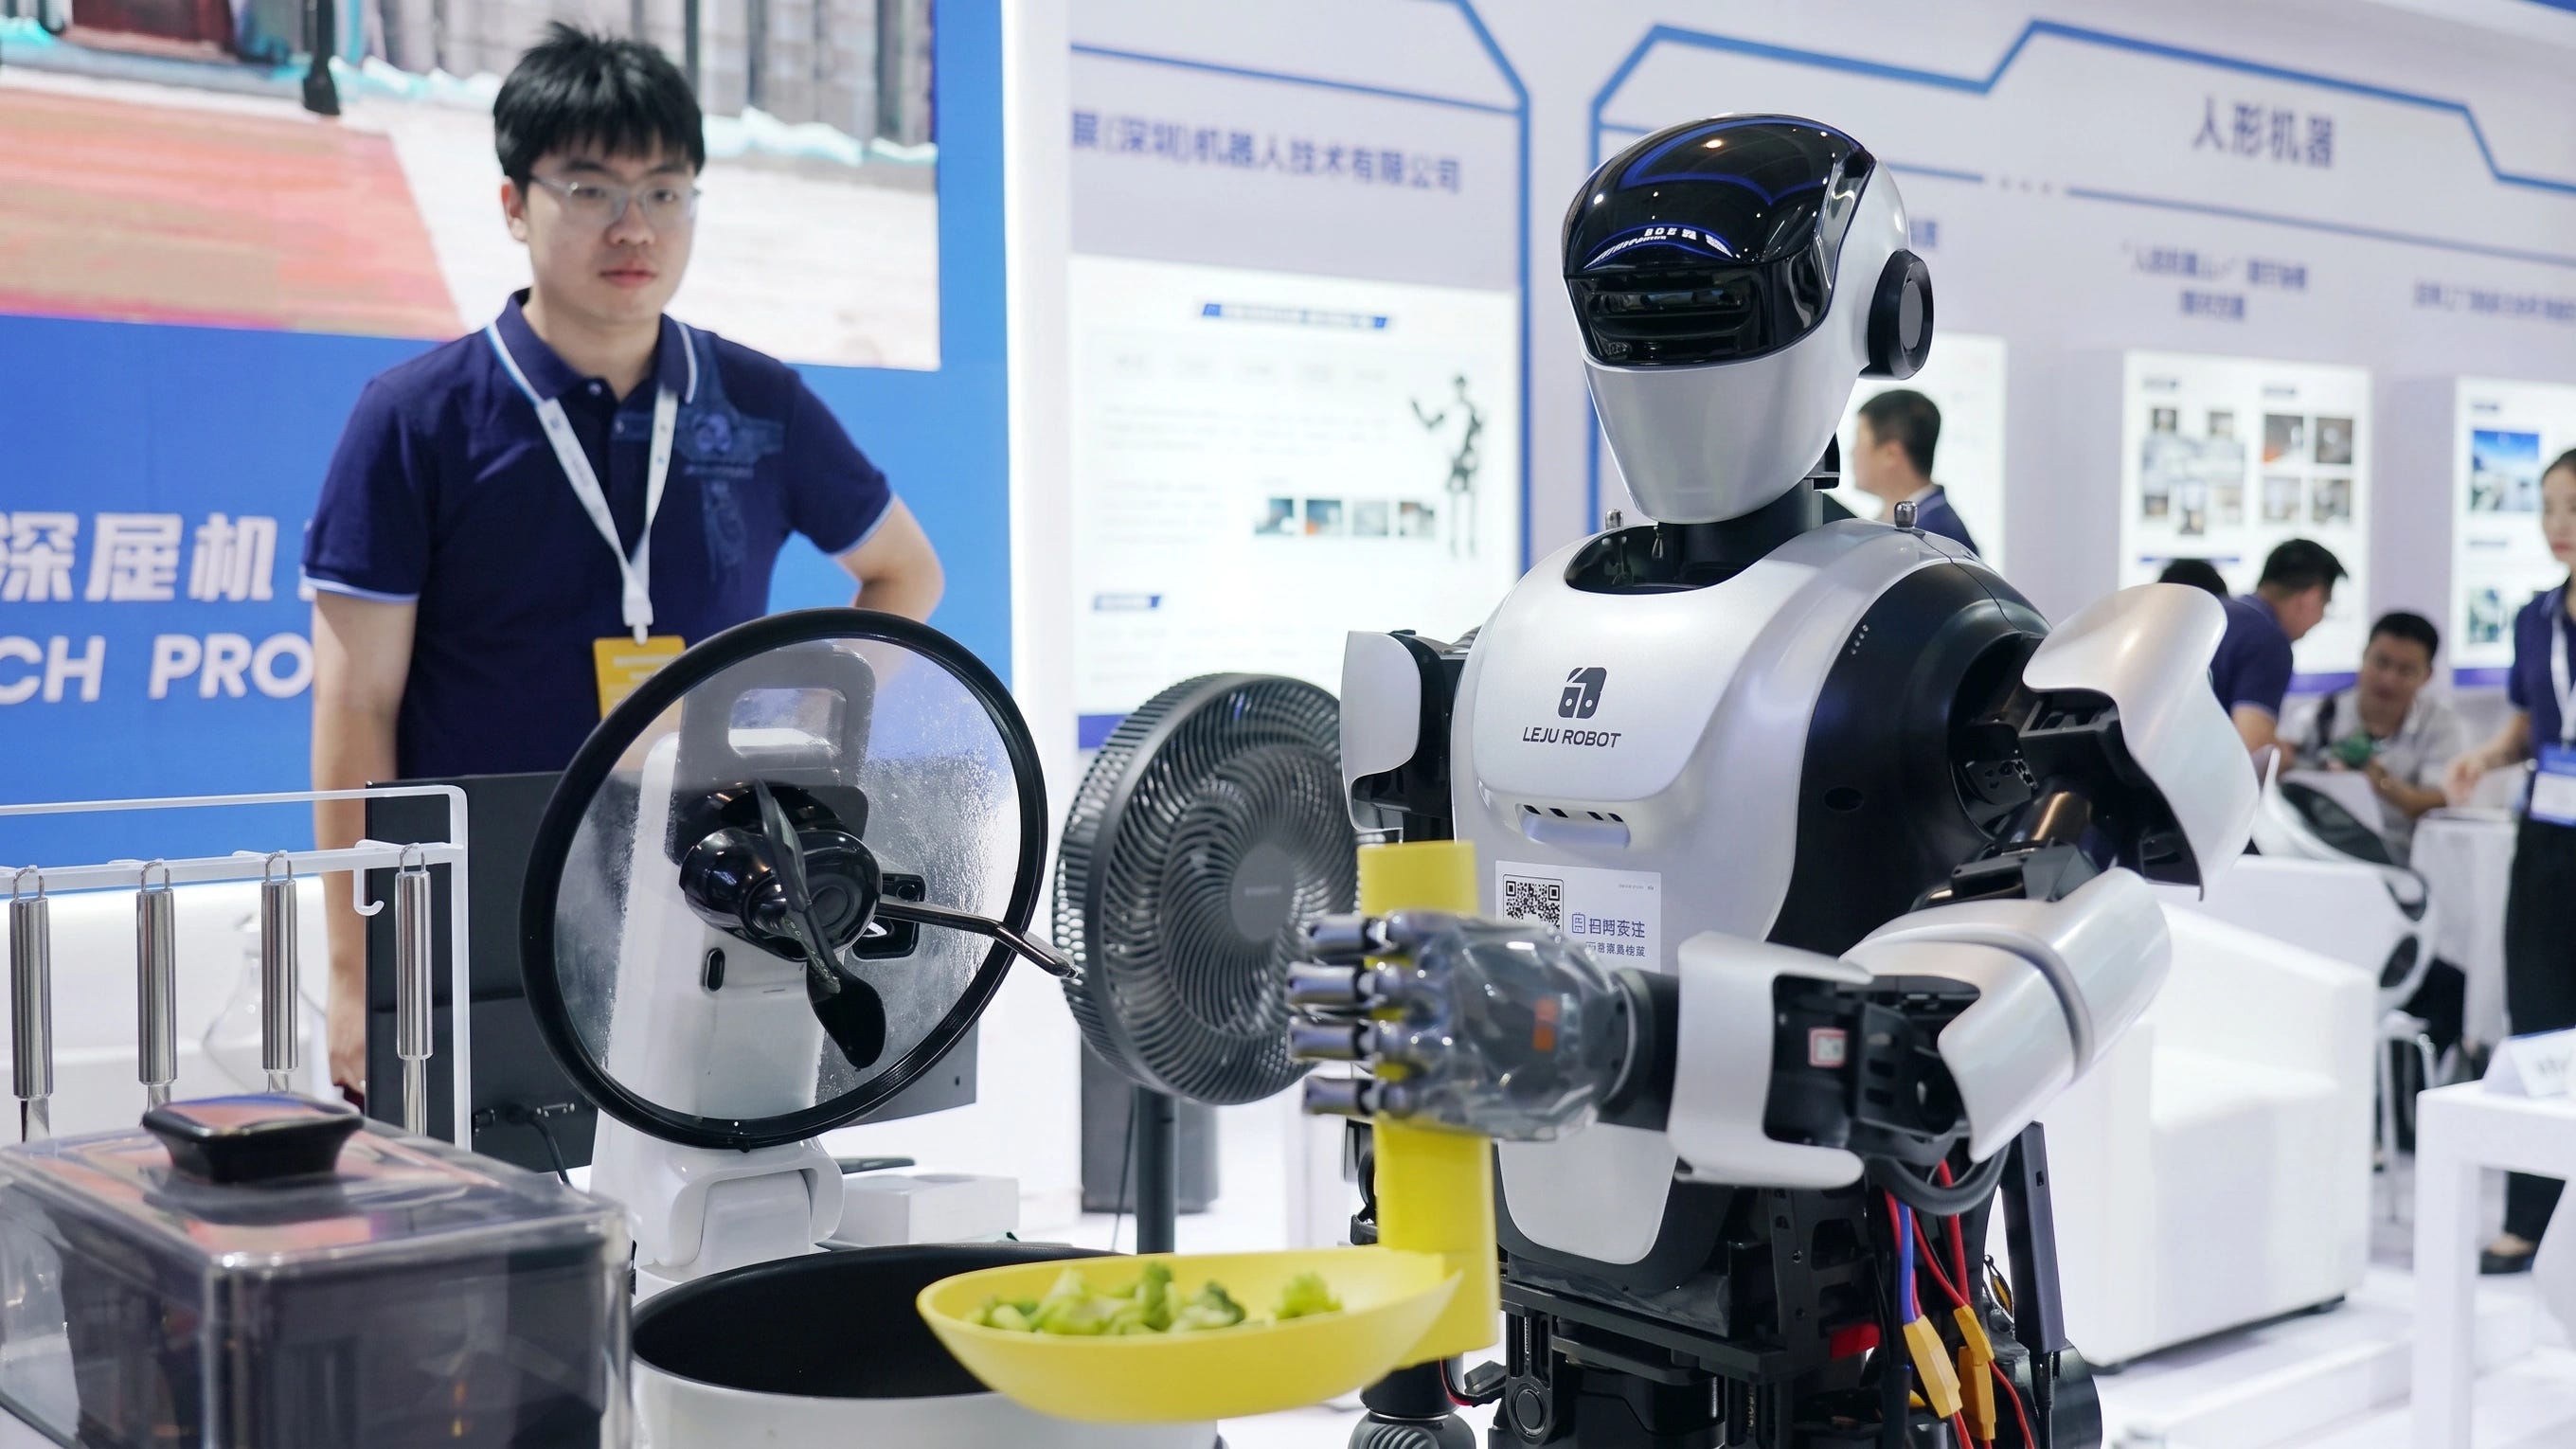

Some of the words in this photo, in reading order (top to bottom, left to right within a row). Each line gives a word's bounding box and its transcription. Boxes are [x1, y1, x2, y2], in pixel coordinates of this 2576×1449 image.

[148, 632, 314, 700] PRO
[1522, 726, 1560, 743] LEJU
[1562, 729, 1621, 748] ROBOT
